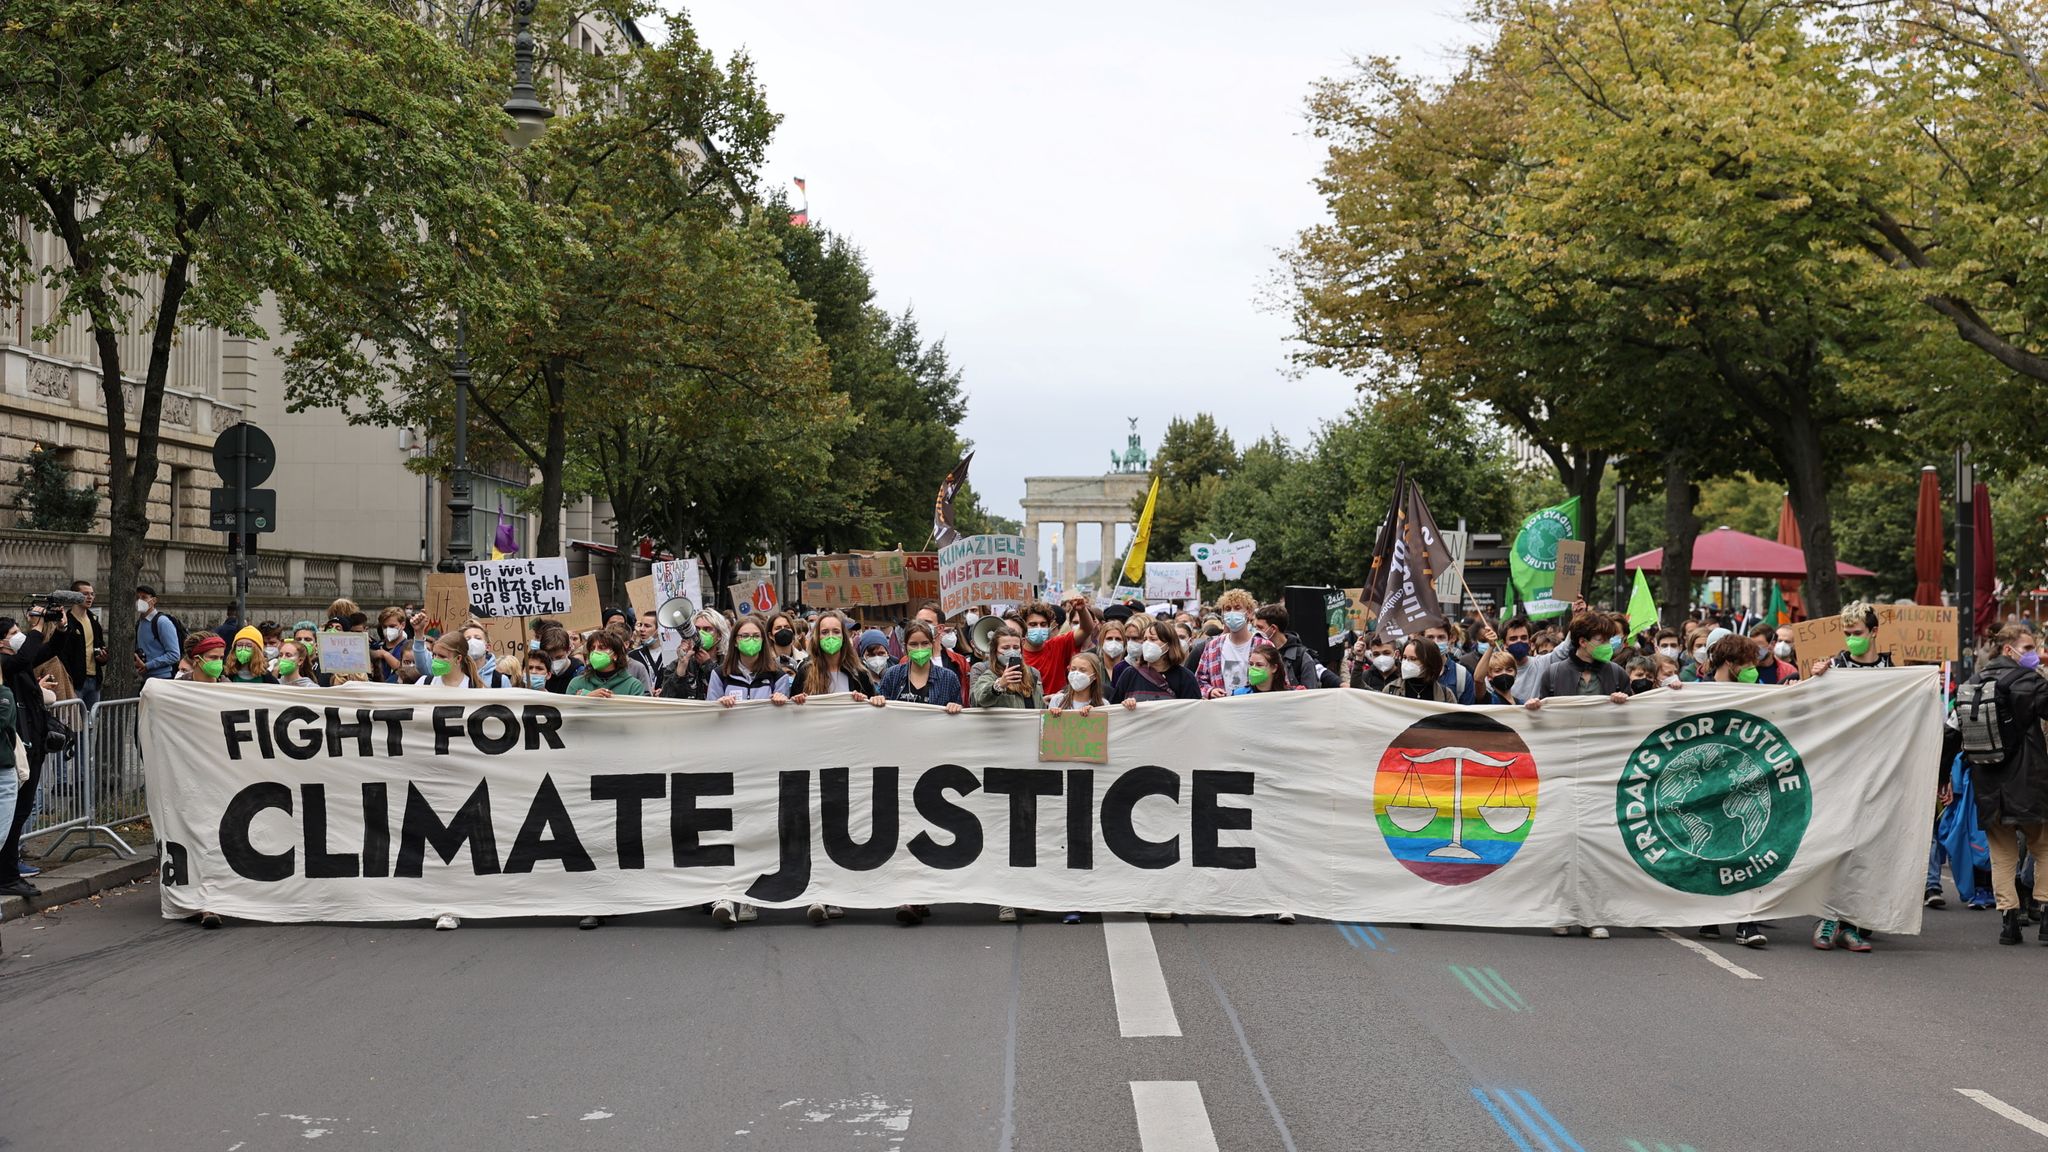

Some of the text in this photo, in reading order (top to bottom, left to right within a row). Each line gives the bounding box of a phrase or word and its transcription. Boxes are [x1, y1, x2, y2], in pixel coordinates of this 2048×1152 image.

[904, 557, 938, 573] ABE
[940, 536, 1025, 567] KLIMAZIELE
[807, 560, 842, 579] SAY
[847, 558, 872, 578] NO
[825, 582, 905, 604] PLASTIK
[942, 586, 970, 613] ABER
[1799, 622, 1817, 643] ES
[221, 704, 566, 760] FIGHT FOR
[1626, 717, 1801, 865] FRIDAYS FOR FUTURE
[219, 764, 1257, 903] CLIMATE JUSTICE
[1719, 849, 1780, 886] Berlin
